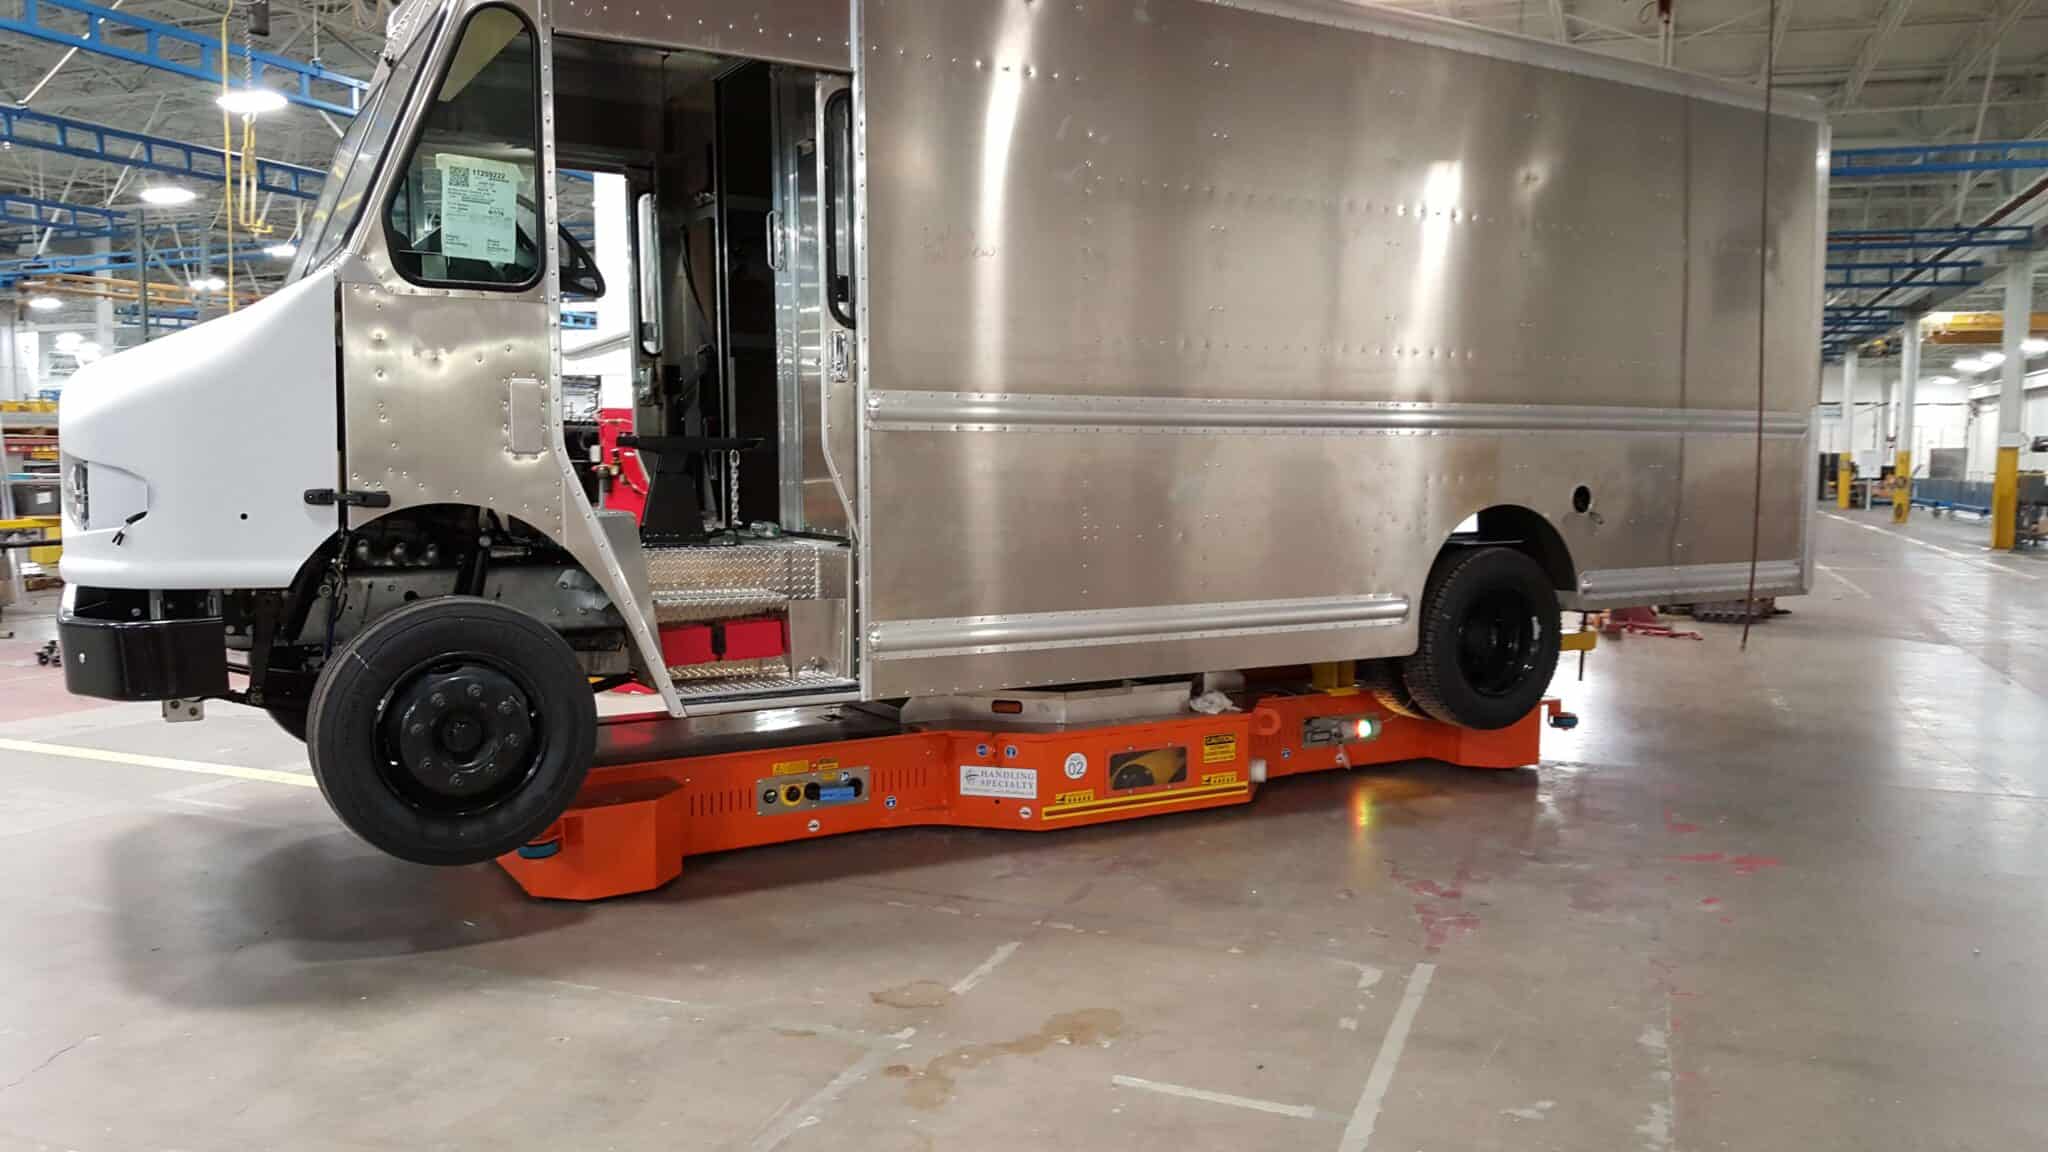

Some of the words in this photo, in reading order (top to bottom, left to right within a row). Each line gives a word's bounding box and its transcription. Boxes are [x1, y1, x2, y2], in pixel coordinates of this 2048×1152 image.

[1067, 761, 1084, 776] 02
[980, 769, 1035, 781] HANDLING
[980, 779, 1034, 790] SPECIALTY
